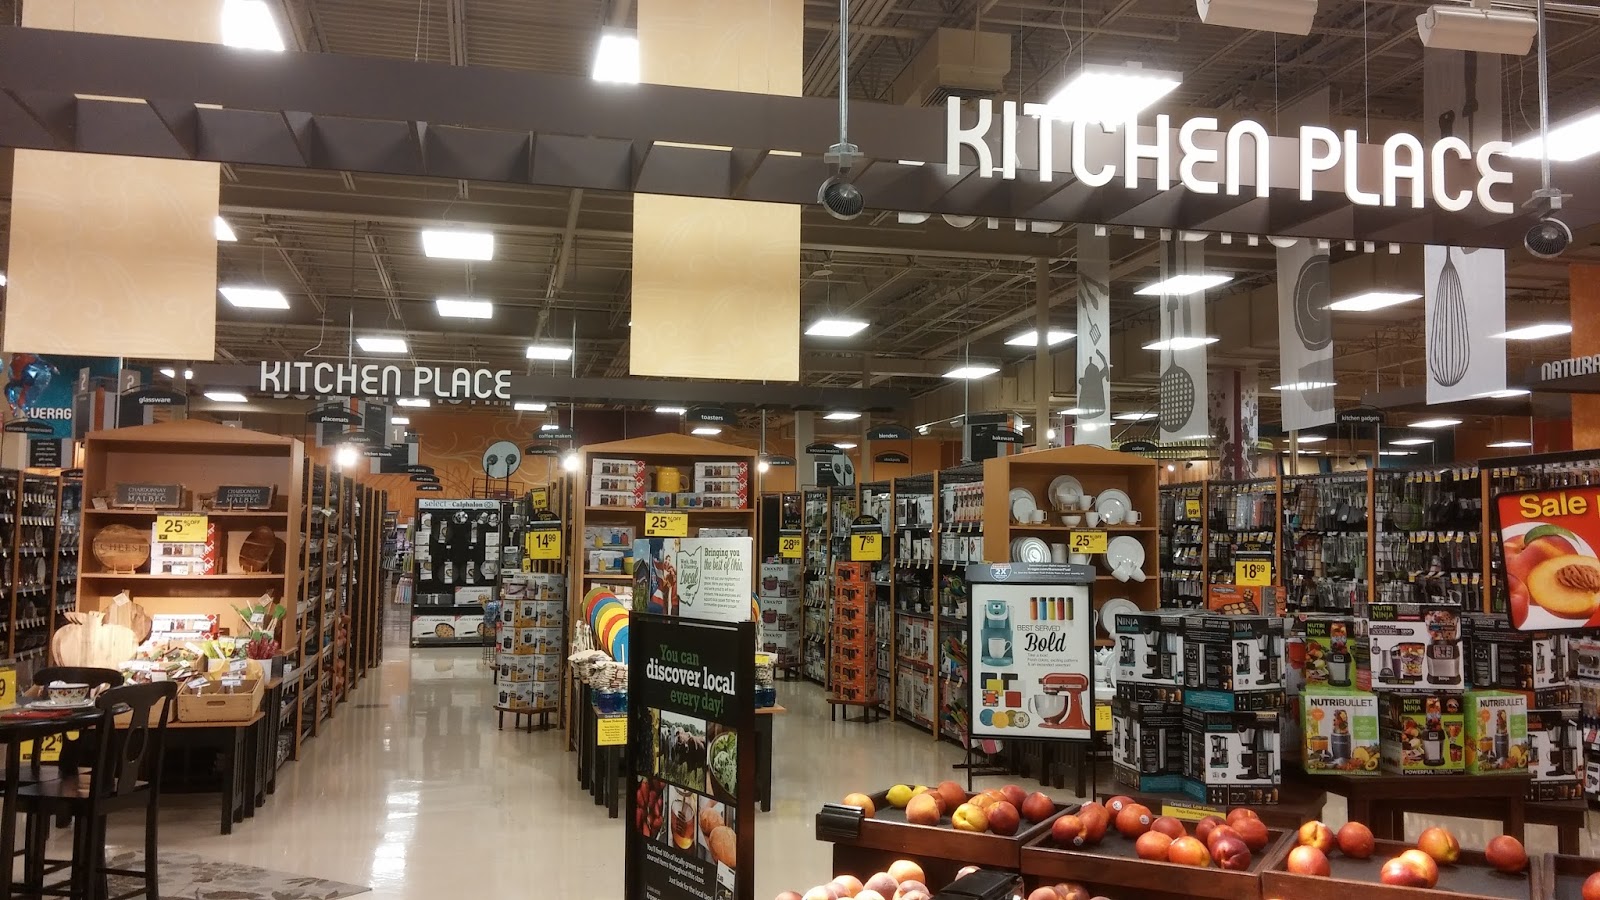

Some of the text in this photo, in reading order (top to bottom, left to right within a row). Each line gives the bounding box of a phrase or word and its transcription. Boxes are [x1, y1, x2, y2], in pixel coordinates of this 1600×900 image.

[946, 95, 1515, 215] KITCHEN PLACE
[260, 360, 512, 400] KITCHEN PLACE
[138, 396, 172, 405] glassware
[28, 407, 72, 420] VERAG
[701, 413, 724, 421] toasters
[1341, 414, 1380, 423] kitchen gadgets
[321, 415, 349, 423] placemats
[992, 434, 1015, 442] bakeware
[451, 501, 484, 509] Calphalon
[1519, 492, 1588, 519] Sale
[100, 543, 145, 552] CHEESE
[704, 548, 740, 559] Bringing you
[1372, 611, 1394, 620] NINJA
[1116, 616, 1139, 628] NINJA
[1016, 624, 1061, 632] BEST SERVED
[1234, 622, 1252, 634] NINJA
[1307, 628, 1326, 636] NINJA
[1024, 632, 1067, 652] Bold
[660, 644, 699, 666] You can
[646, 658, 736, 695] discover local
[670, 689, 724, 718] every day!
[1403, 704, 1422, 713] NINJA
